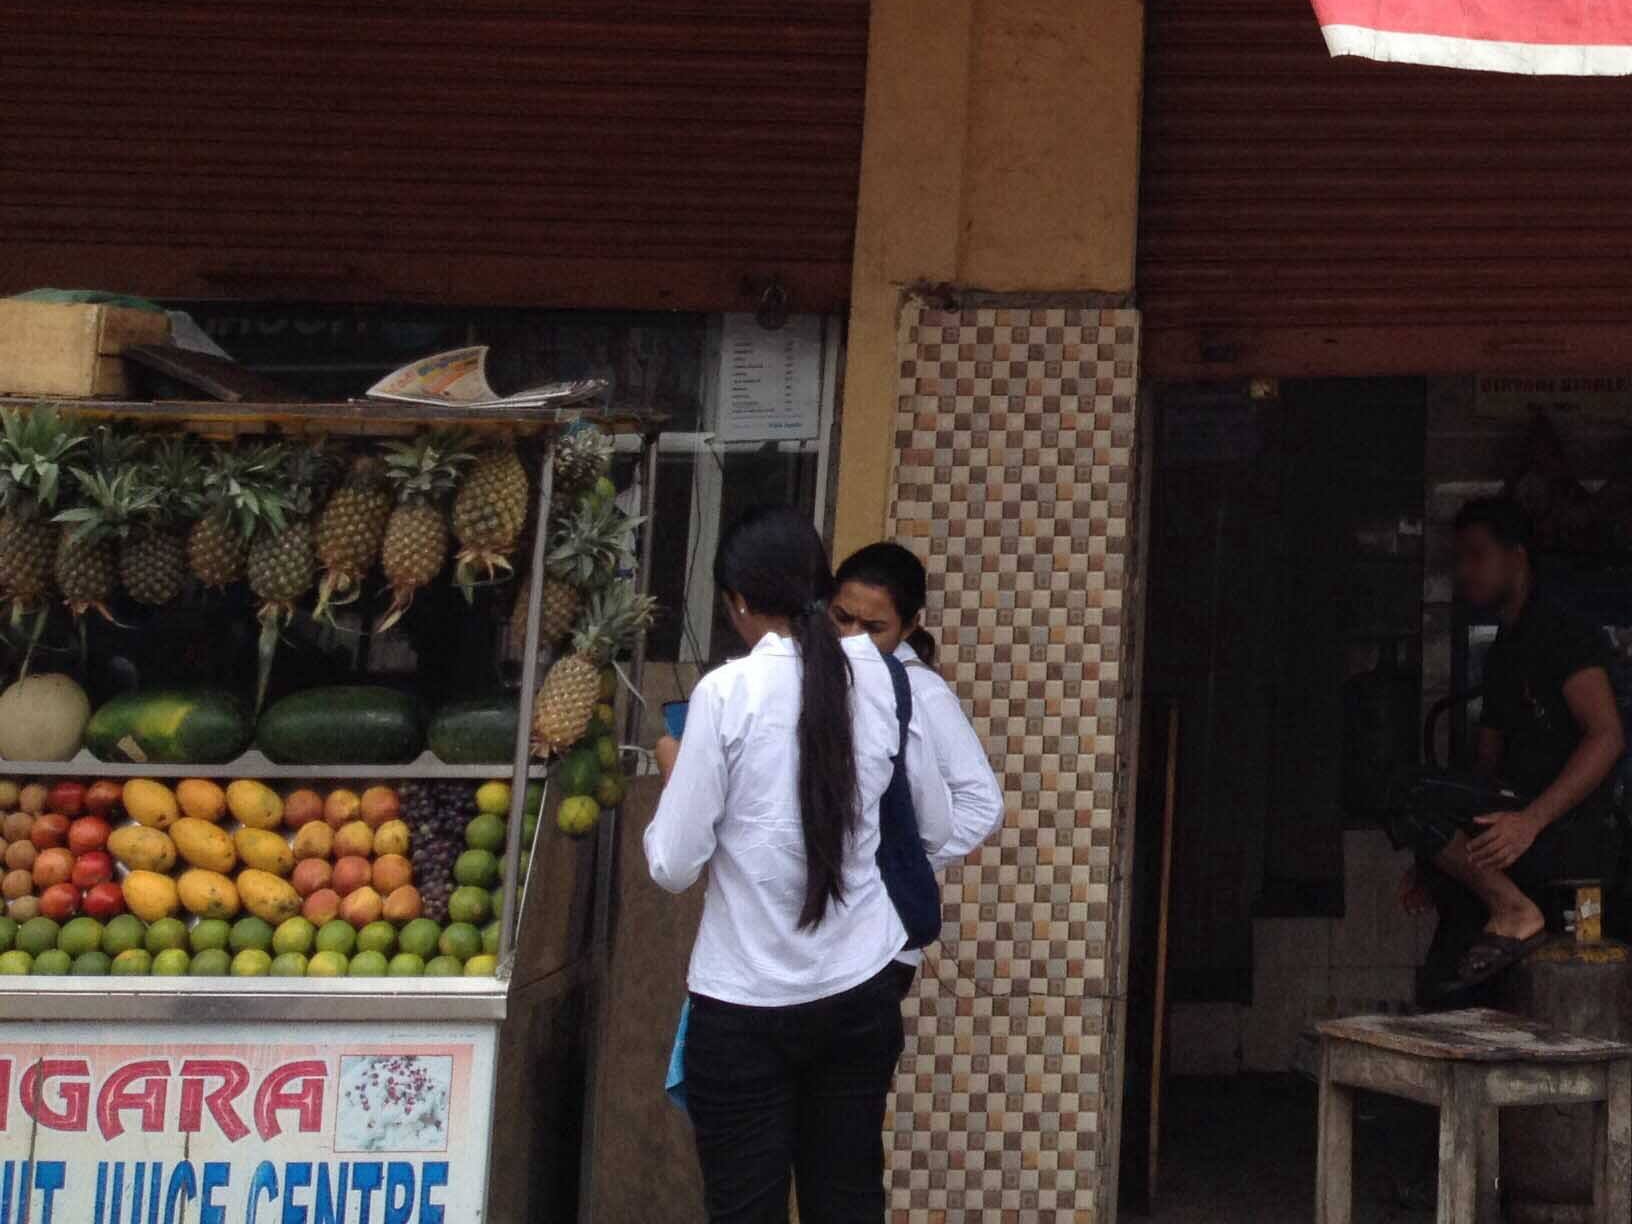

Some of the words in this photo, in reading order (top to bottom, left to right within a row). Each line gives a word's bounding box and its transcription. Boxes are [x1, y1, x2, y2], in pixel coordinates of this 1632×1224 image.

[0, 1059, 328, 1143] GARA
[94, 1160, 231, 1224] JUICE
[246, 1160, 450, 1224] CENTRE
